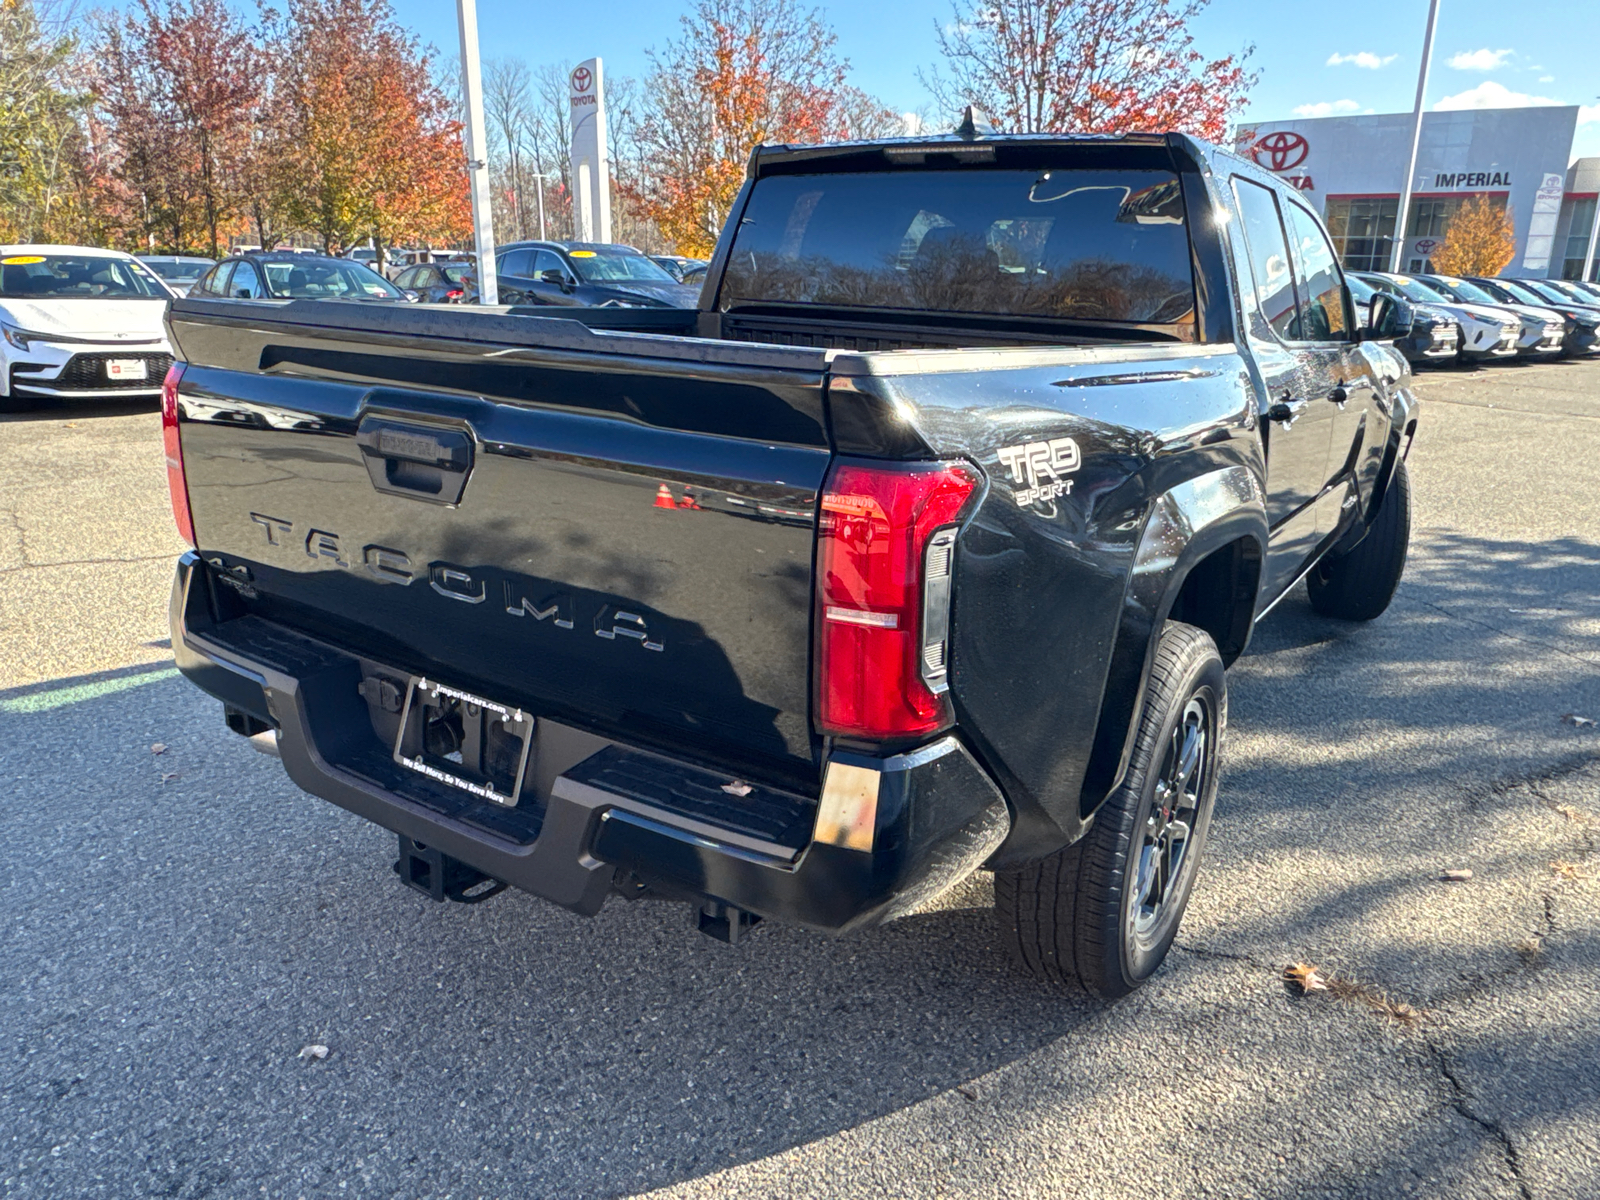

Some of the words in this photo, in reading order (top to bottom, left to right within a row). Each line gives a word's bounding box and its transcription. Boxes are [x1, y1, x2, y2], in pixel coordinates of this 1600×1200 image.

[571, 95, 597, 107] TOYOTA
[1435, 172, 1512, 187] IMPERIAL
[996, 437, 1081, 490] TRD
[1015, 479, 1074, 506] SPORT
[250, 511, 665, 652] TACOMA
[403, 757, 413, 768] We
[413, 762, 426, 773] Sell
[426, 766, 443, 781] More,
[444, 774, 454, 784] So
[455, 777, 468, 789] You
[468, 783, 485, 796] Save
[486, 789, 504, 803] More
